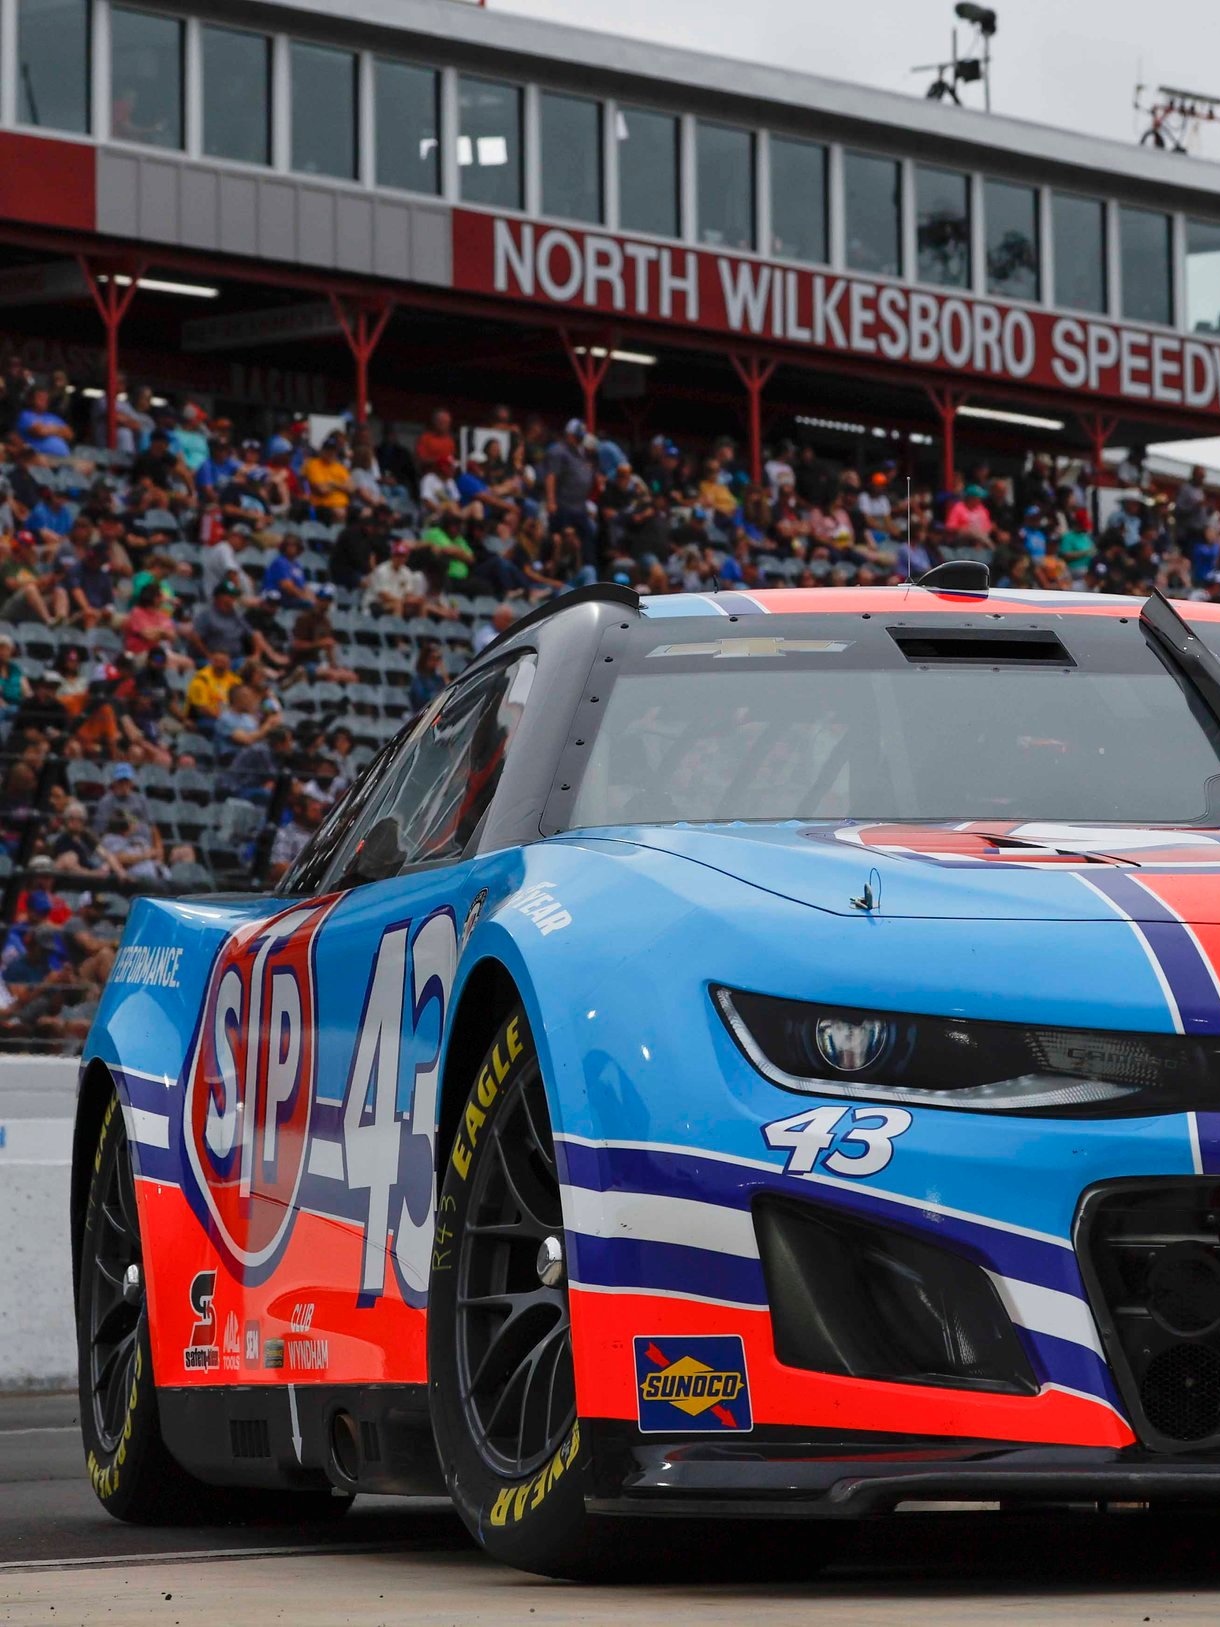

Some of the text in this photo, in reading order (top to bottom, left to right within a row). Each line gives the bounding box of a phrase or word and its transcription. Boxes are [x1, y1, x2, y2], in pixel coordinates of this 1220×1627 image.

[493, 218, 699, 322] NORTH
[716, 256, 1036, 380] WILKESBORO
[205, 905, 323, 1198] STP
[342, 903, 458, 1302] 43
[452, 1016, 524, 1182] EAGLE
[761, 1106, 913, 1178] 43
[432, 1195, 456, 1270] R43
[290, 1303, 315, 1333] CLUB
[223, 1356, 241, 1370] TOOLS
[288, 1340, 329, 1370] WYNDHAM
[646, 1375, 739, 1398] SUNOCO
